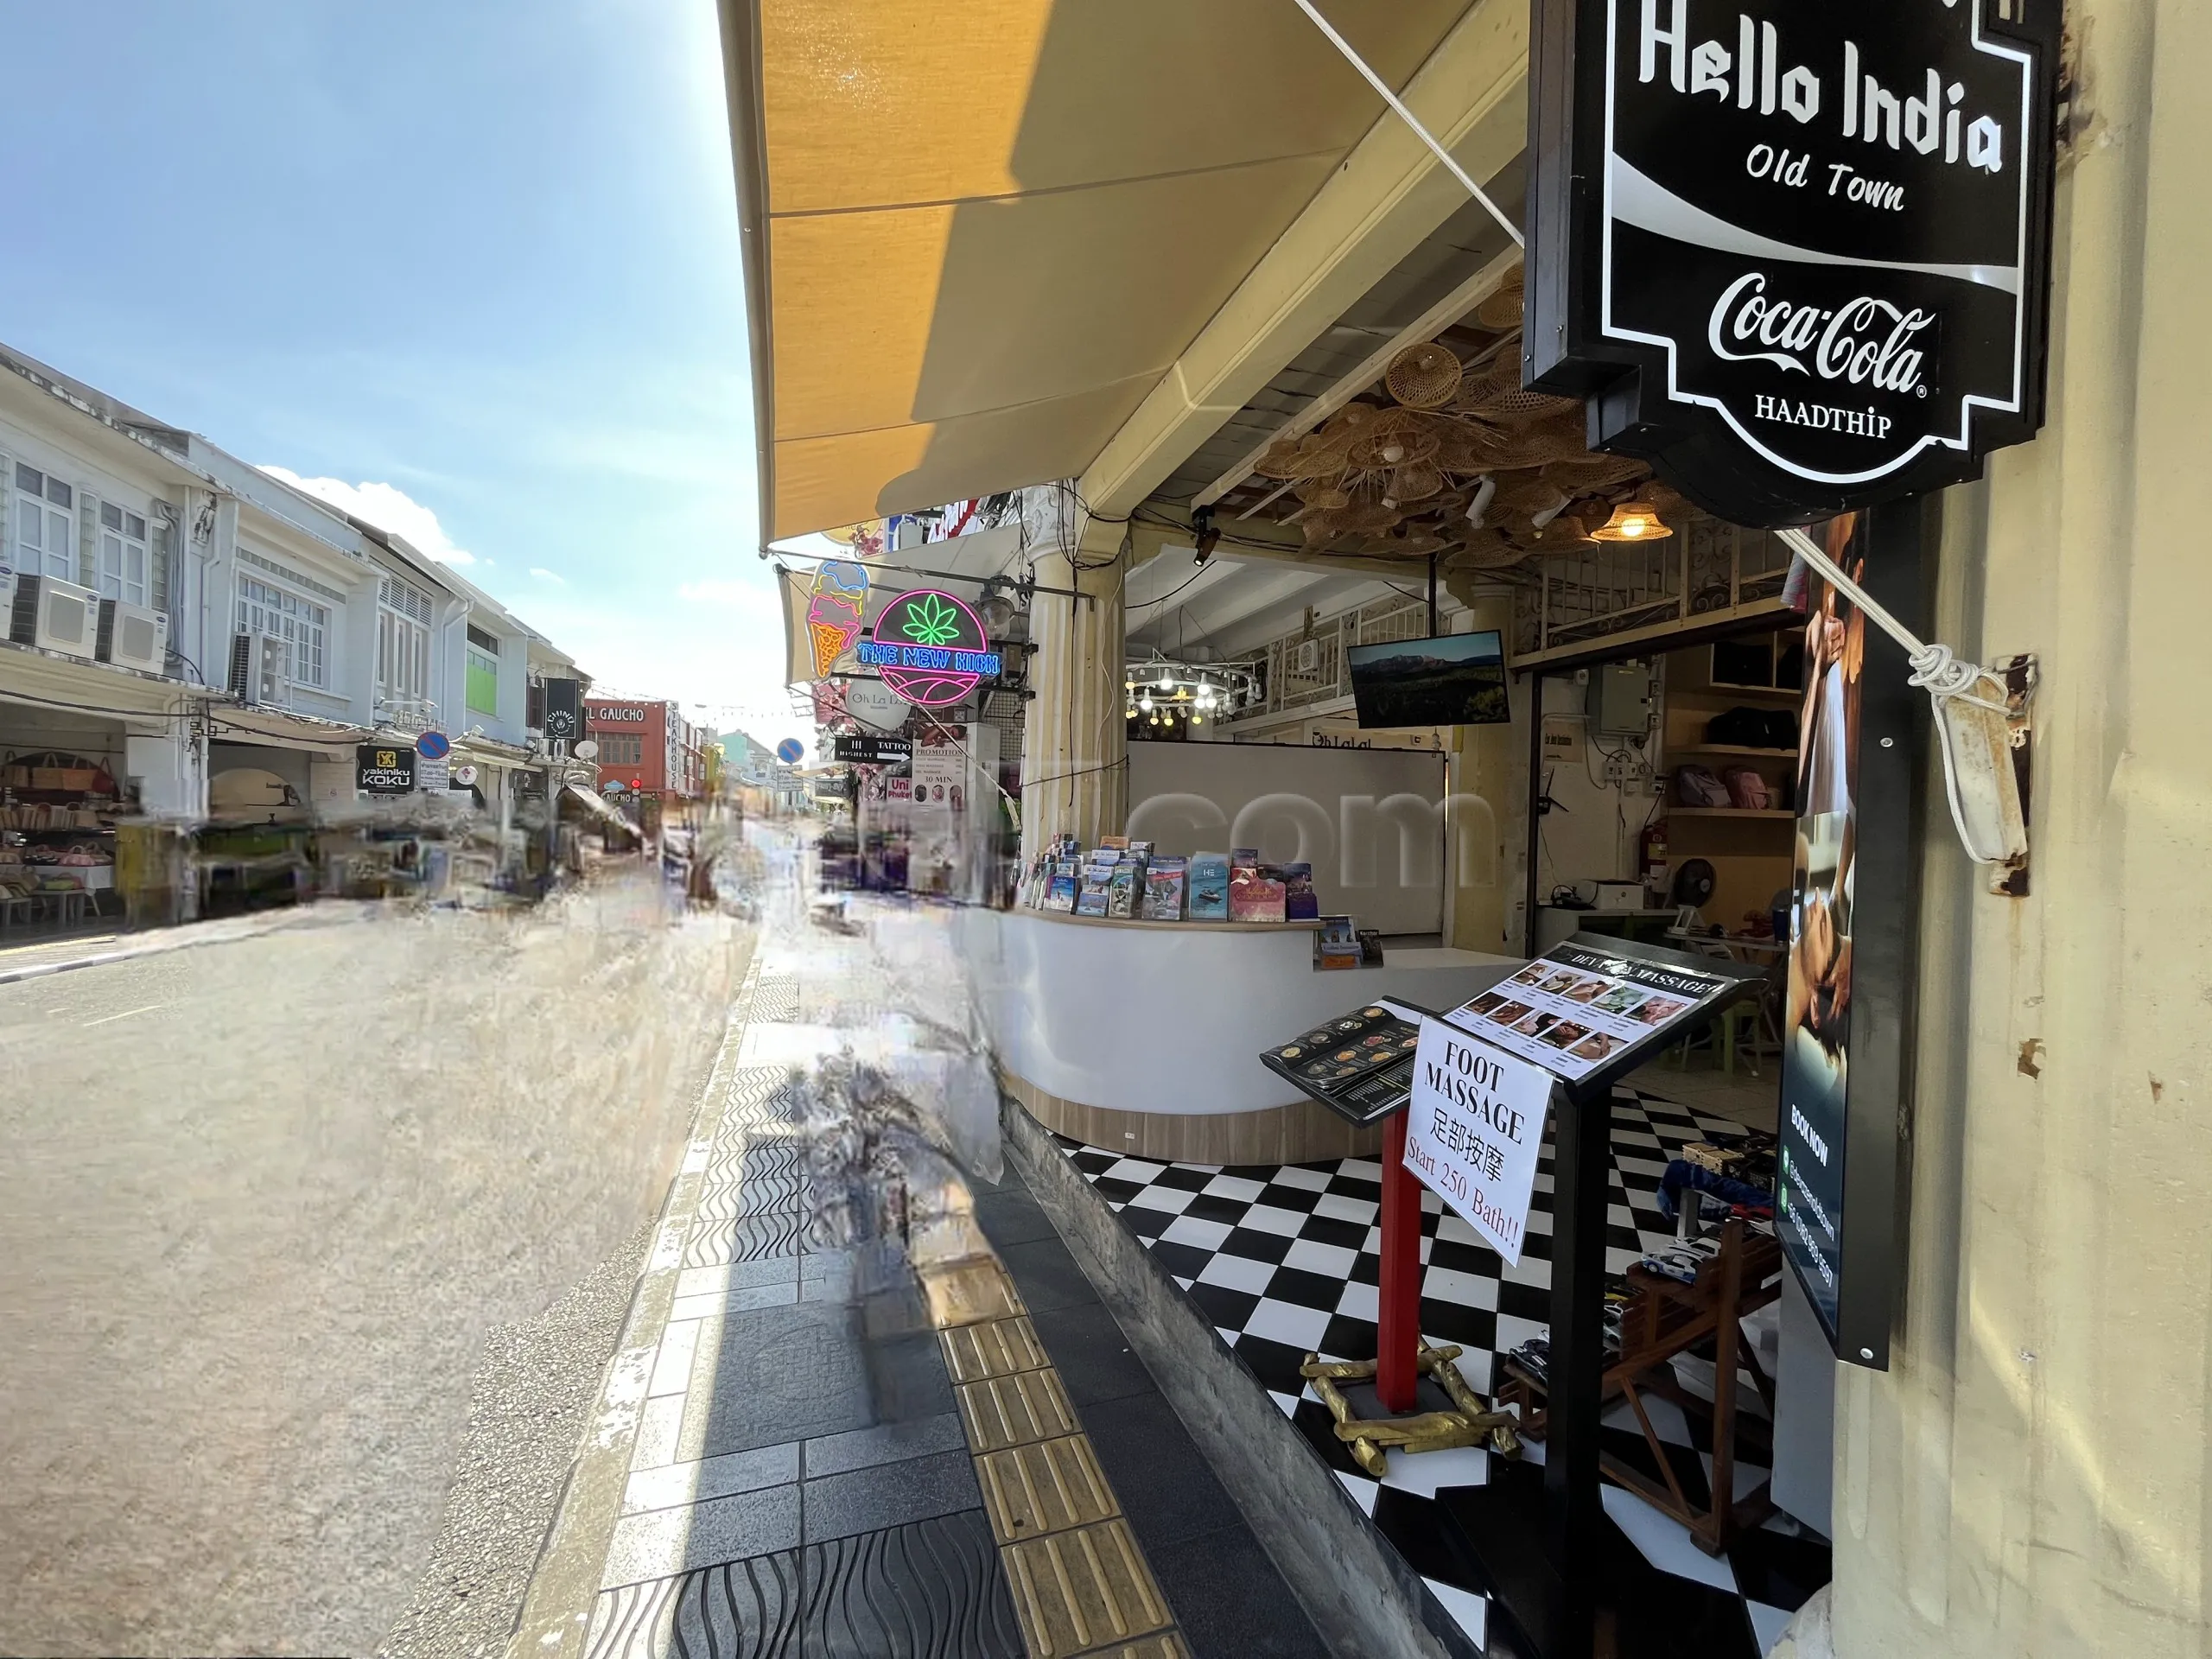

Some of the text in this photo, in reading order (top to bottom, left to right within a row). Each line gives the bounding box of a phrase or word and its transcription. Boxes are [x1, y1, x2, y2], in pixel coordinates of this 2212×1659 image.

[1638, 0, 2004, 175] Hello India
[1746, 144, 1904, 213] Old Town
[858, 643, 1000, 674] THE NEW HIGH
[600, 707, 645, 722] GAUCHO
[362, 767, 410, 776] yakiniku
[877, 741, 912, 751] TATTOO
[362, 775, 410, 785] KOKU
[891, 779, 910, 790] Uni
[1444, 1040, 1504, 1094] FOOT
[1424, 1062, 1525, 1147] MASSAGE
[1429, 1108, 1505, 1183] 足部按摩
[1791, 1103, 1828, 1167] BOOK NOW
[1408, 1135, 1520, 1249] Start 250 Bath!!
